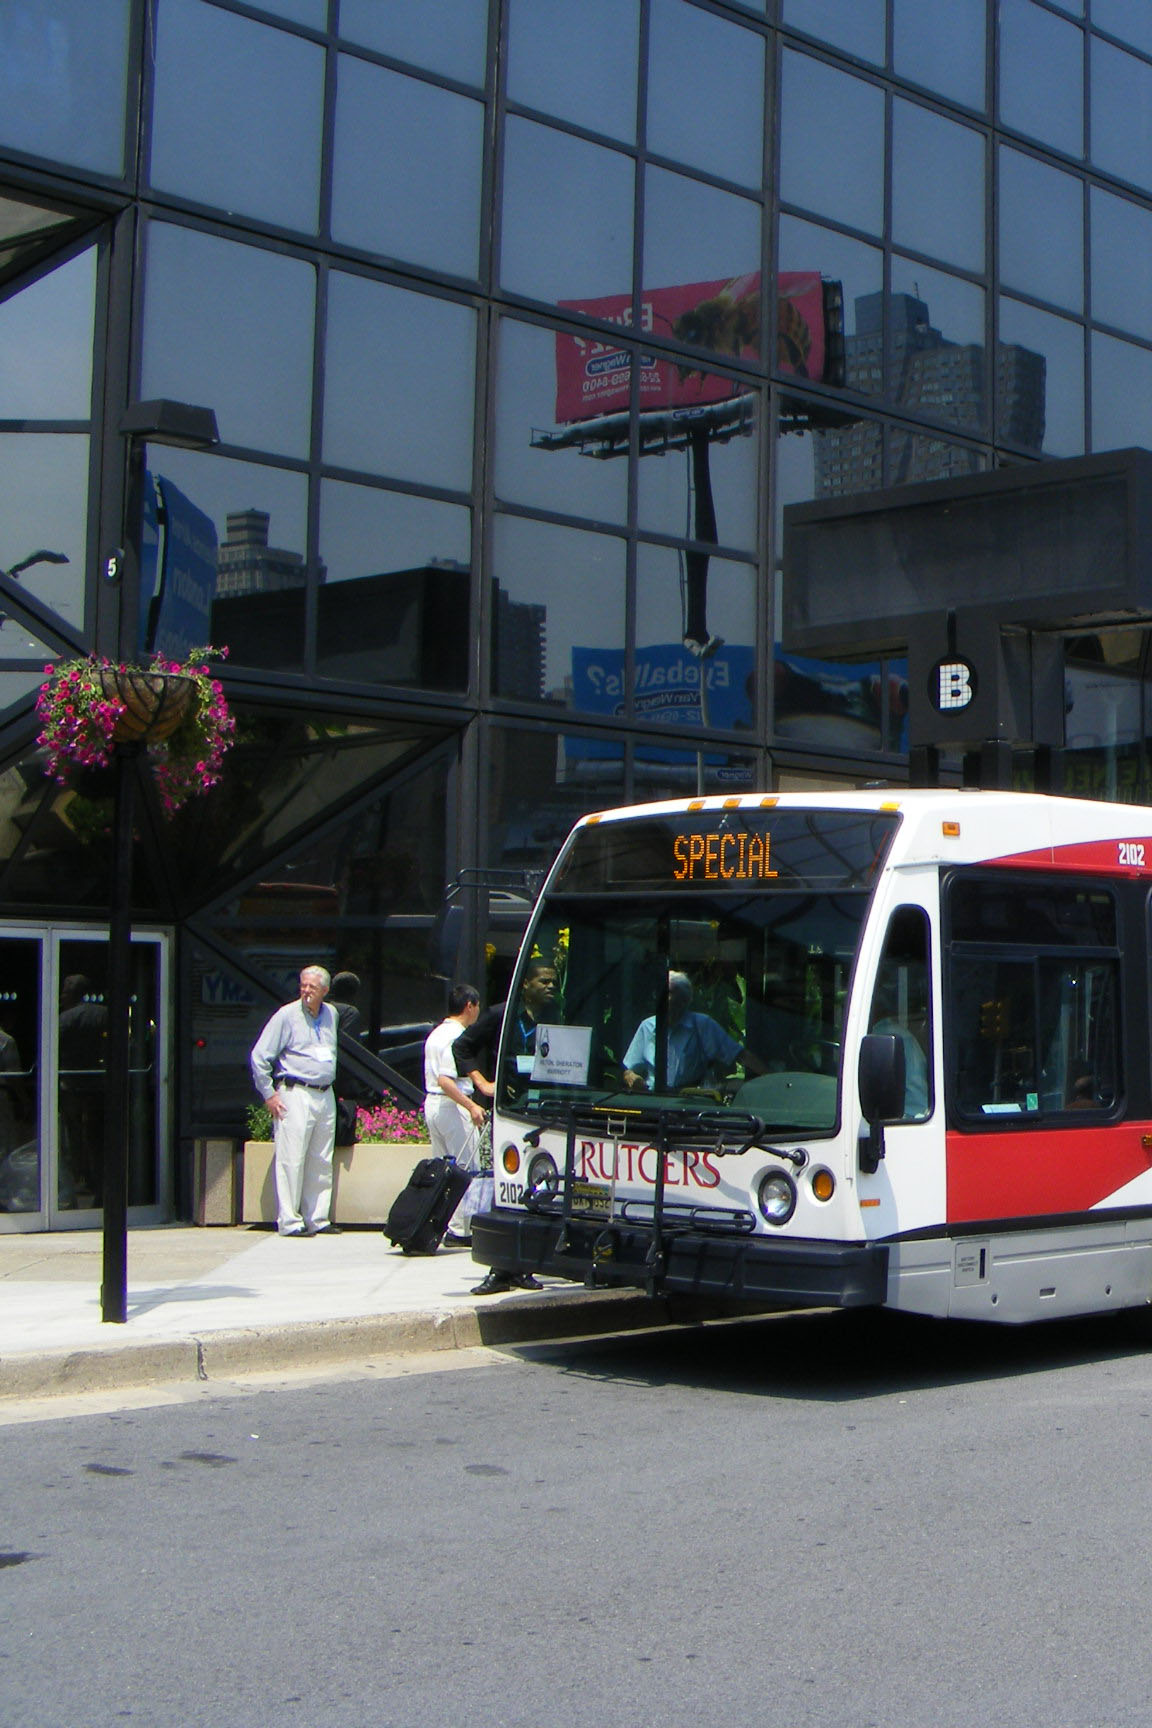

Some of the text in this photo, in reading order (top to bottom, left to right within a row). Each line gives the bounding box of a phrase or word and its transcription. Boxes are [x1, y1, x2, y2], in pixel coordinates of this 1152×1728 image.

[107, 556, 117, 577] 5
[938, 663, 972, 710] B
[673, 832, 779, 879] SPECIAL
[1118, 842, 1146, 867] 2102
[580, 1140, 721, 1188] RUTGERS
[499, 1181, 525, 1205] 2102
